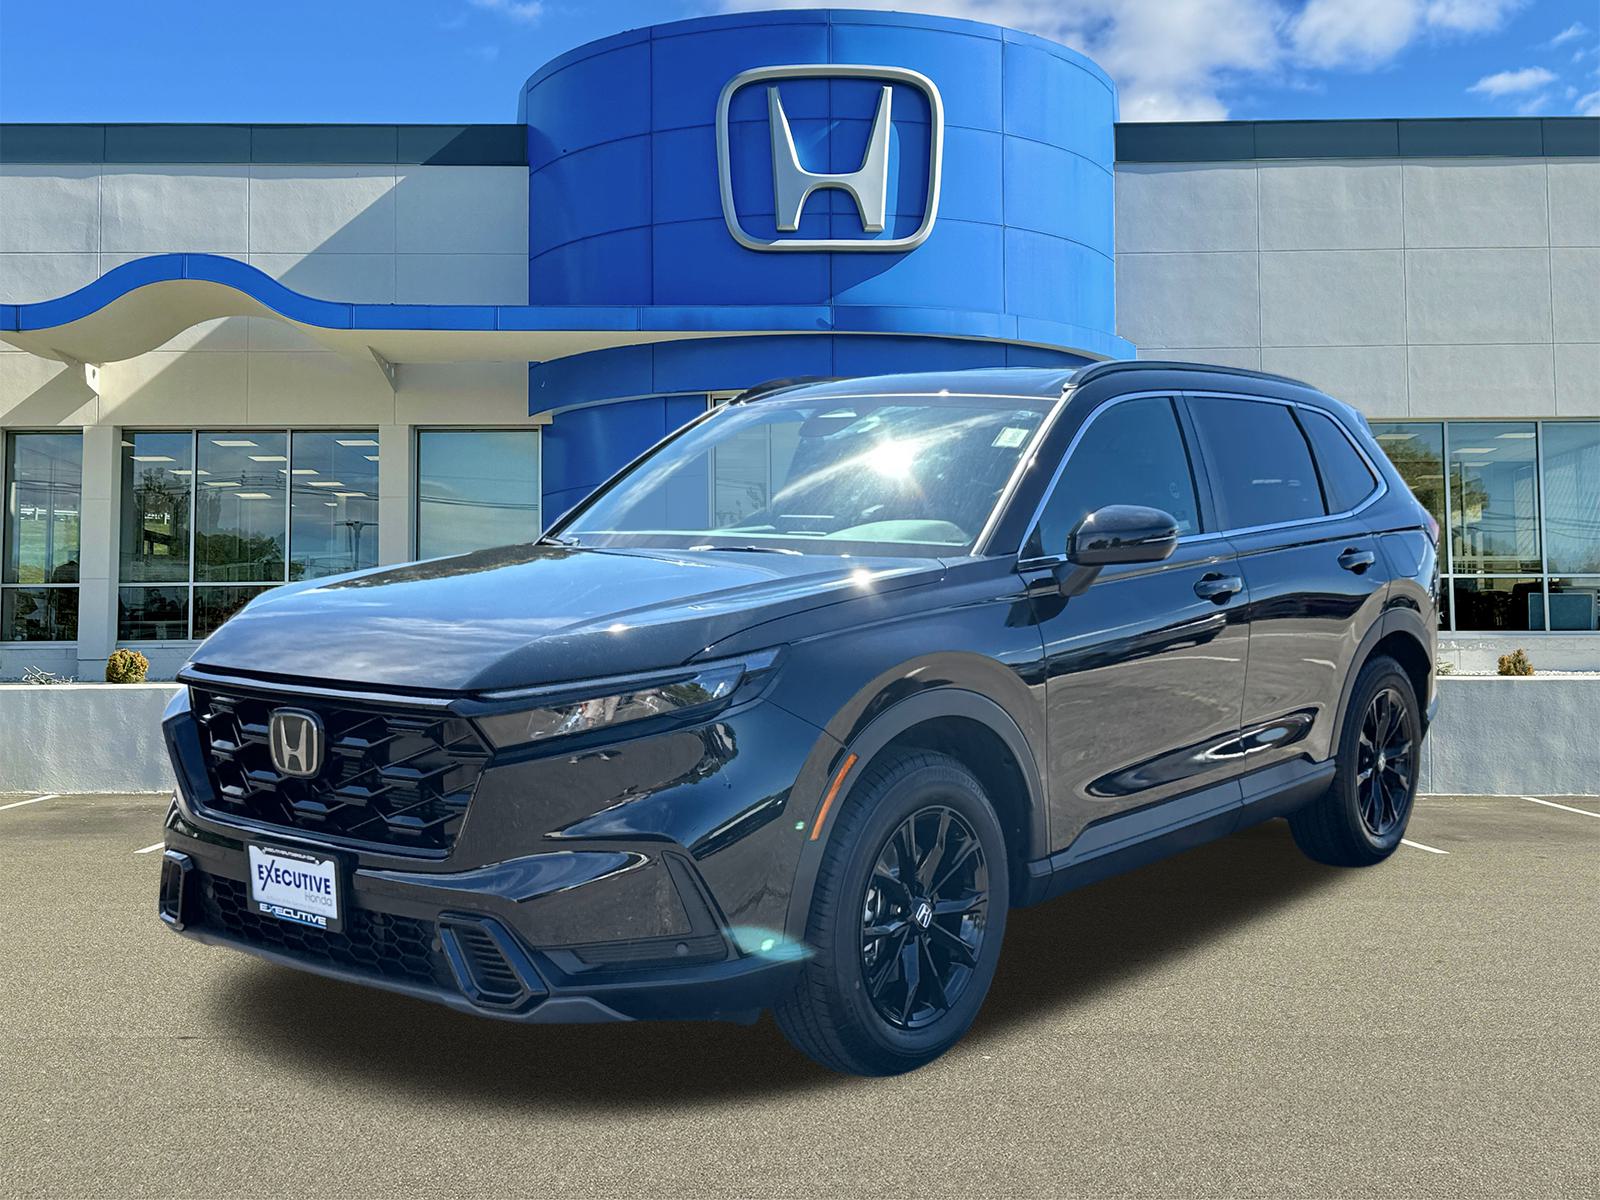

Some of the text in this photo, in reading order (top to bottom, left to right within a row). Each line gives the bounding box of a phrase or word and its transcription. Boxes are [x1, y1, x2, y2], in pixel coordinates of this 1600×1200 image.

[257, 859, 331, 895] EXECUTIVE
[304, 892, 333, 907] Honda
[259, 902, 327, 926] EXECUTIVE
